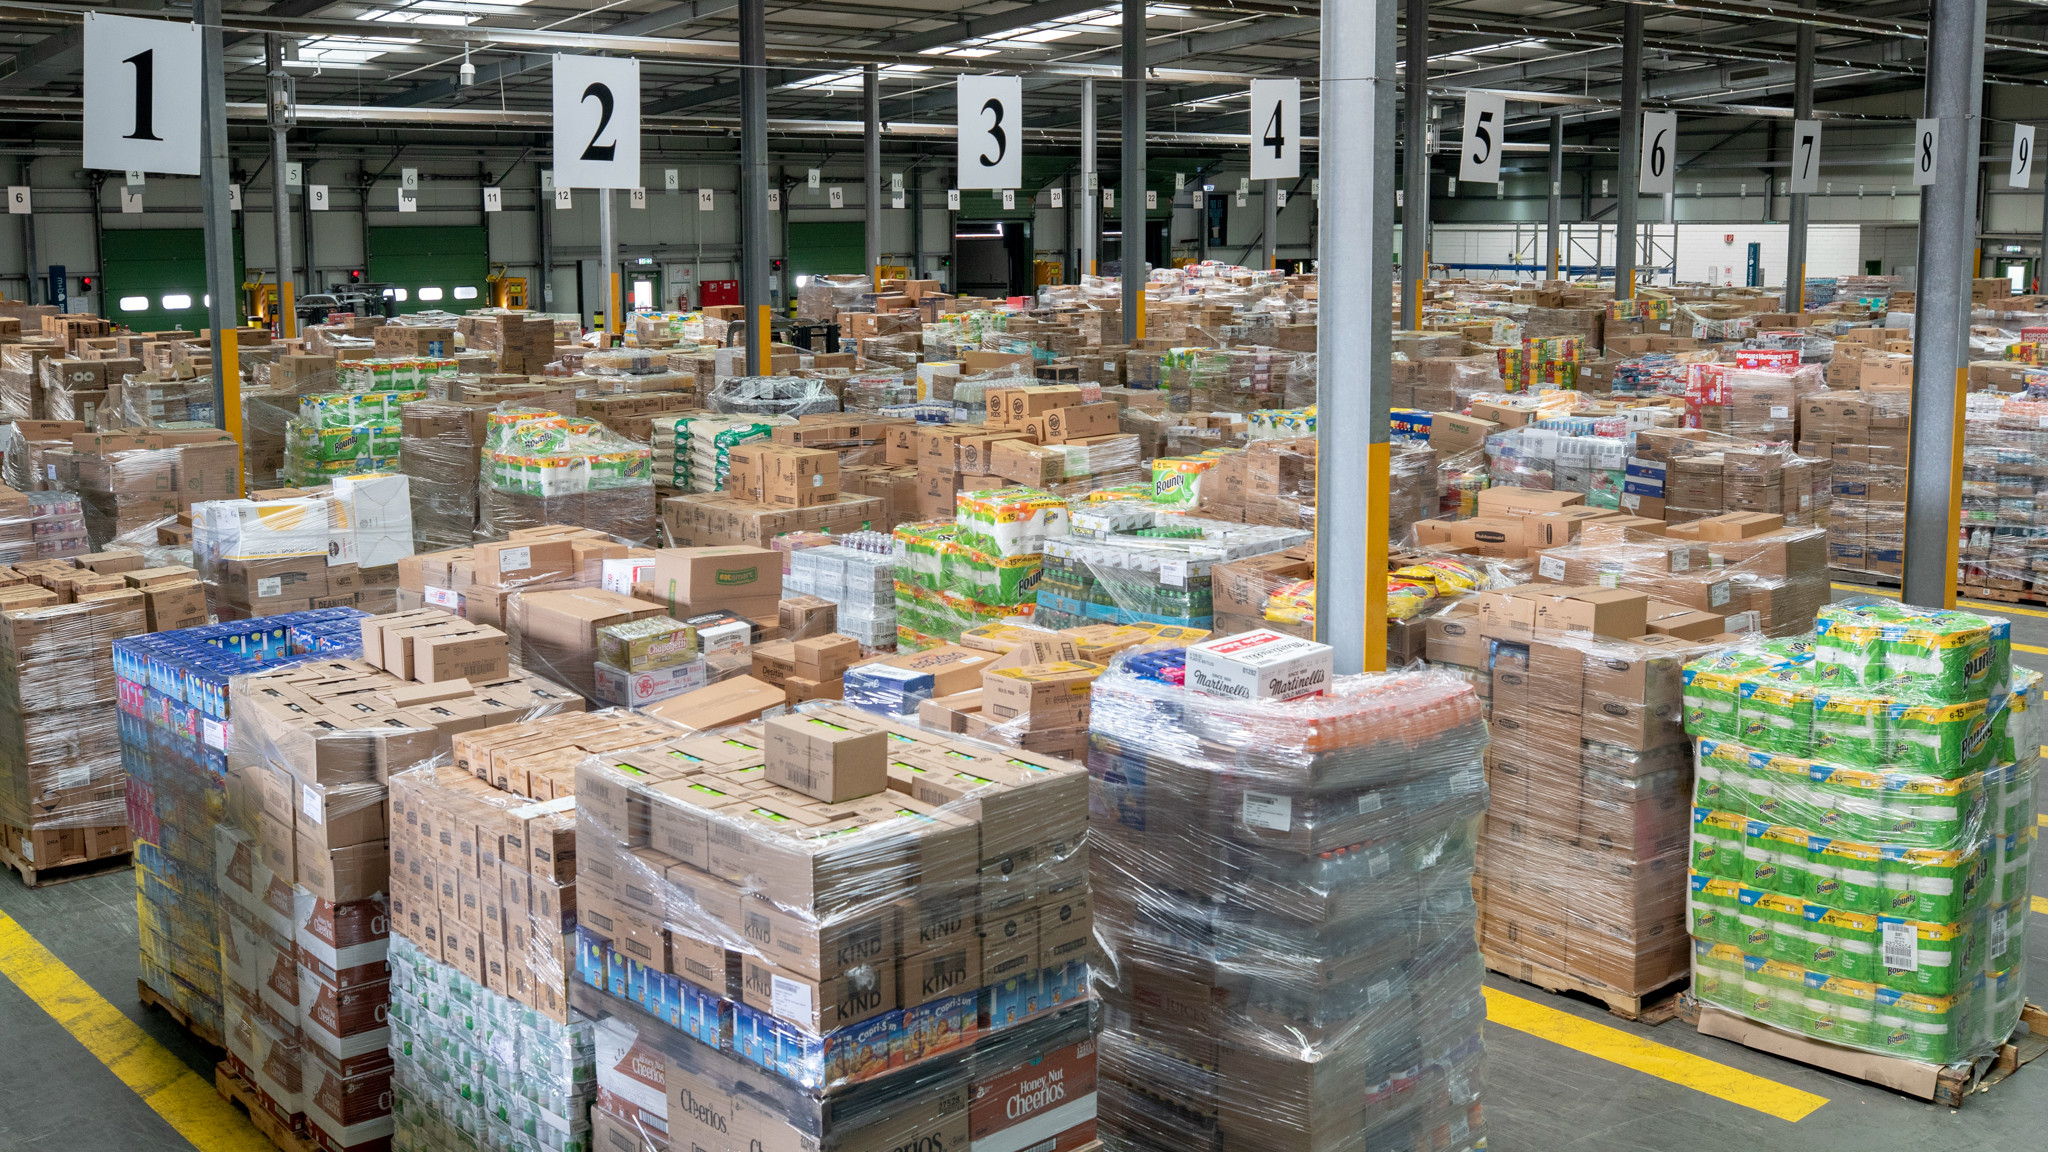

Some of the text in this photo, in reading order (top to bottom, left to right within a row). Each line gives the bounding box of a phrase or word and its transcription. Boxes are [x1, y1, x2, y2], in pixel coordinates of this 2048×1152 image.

[121, 48, 164, 142] 1
[580, 82, 618, 162] 2
[979, 98, 1007, 167] 3
[1263, 99, 1286, 161] 4
[1472, 111, 1493, 166] 5
[1650, 127, 1666, 178] 6
[1801, 135, 1815, 180] 7
[1920, 131, 1933, 173] 8
[2018, 137, 2030, 176] 9
[290, 170, 297, 180] 5
[406, 175, 414, 185] 6
[668, 175, 675, 184] 8
[811, 174, 817, 184] 9
[893, 178, 902, 188] 10
[15, 192, 23, 203] 6
[316, 192, 323, 201] 9
[487, 193, 497, 202] 11
[558, 191, 569, 200] 12
[633, 191, 643, 200] 13
[701, 193, 711, 202] 14
[768, 194, 778, 202] 15
[832, 191, 841, 200] 16
[950, 193, 958, 201] 18
[1005, 193, 1012, 201] 19
[175, 324, 182, 332] 5
[335, 435, 358, 453] Bounty
[1156, 474, 1184, 497] Bounty
[762, 666, 784, 679] Desitin
[1194, 669, 1250, 699] Martinelli's
[1269, 669, 1325, 696] Martinelli's
[1893, 820, 1917, 832] Bounty
[1755, 867, 1776, 879] Bounty
[1817, 882, 1839, 895] Bounty
[1892, 894, 1916, 909] Bounty
[745, 922, 771, 944] KIND
[920, 918, 961, 944] KIND
[1748, 933, 1770, 944] Bounty
[837, 938, 881, 966] KIND
[1814, 949, 1836, 961] Bounty
[745, 977, 771, 998] KIND
[923, 969, 966, 995] KIND
[837, 992, 881, 1020] KIND
[1887, 1033, 1911, 1045] Bounty
[632, 1057, 665, 1085] Cheerios
[1020, 1068, 1063, 1095] Honey Nut
[1006, 1082, 1065, 1120] Cheerios
[680, 1088, 728, 1135] Cheerios
